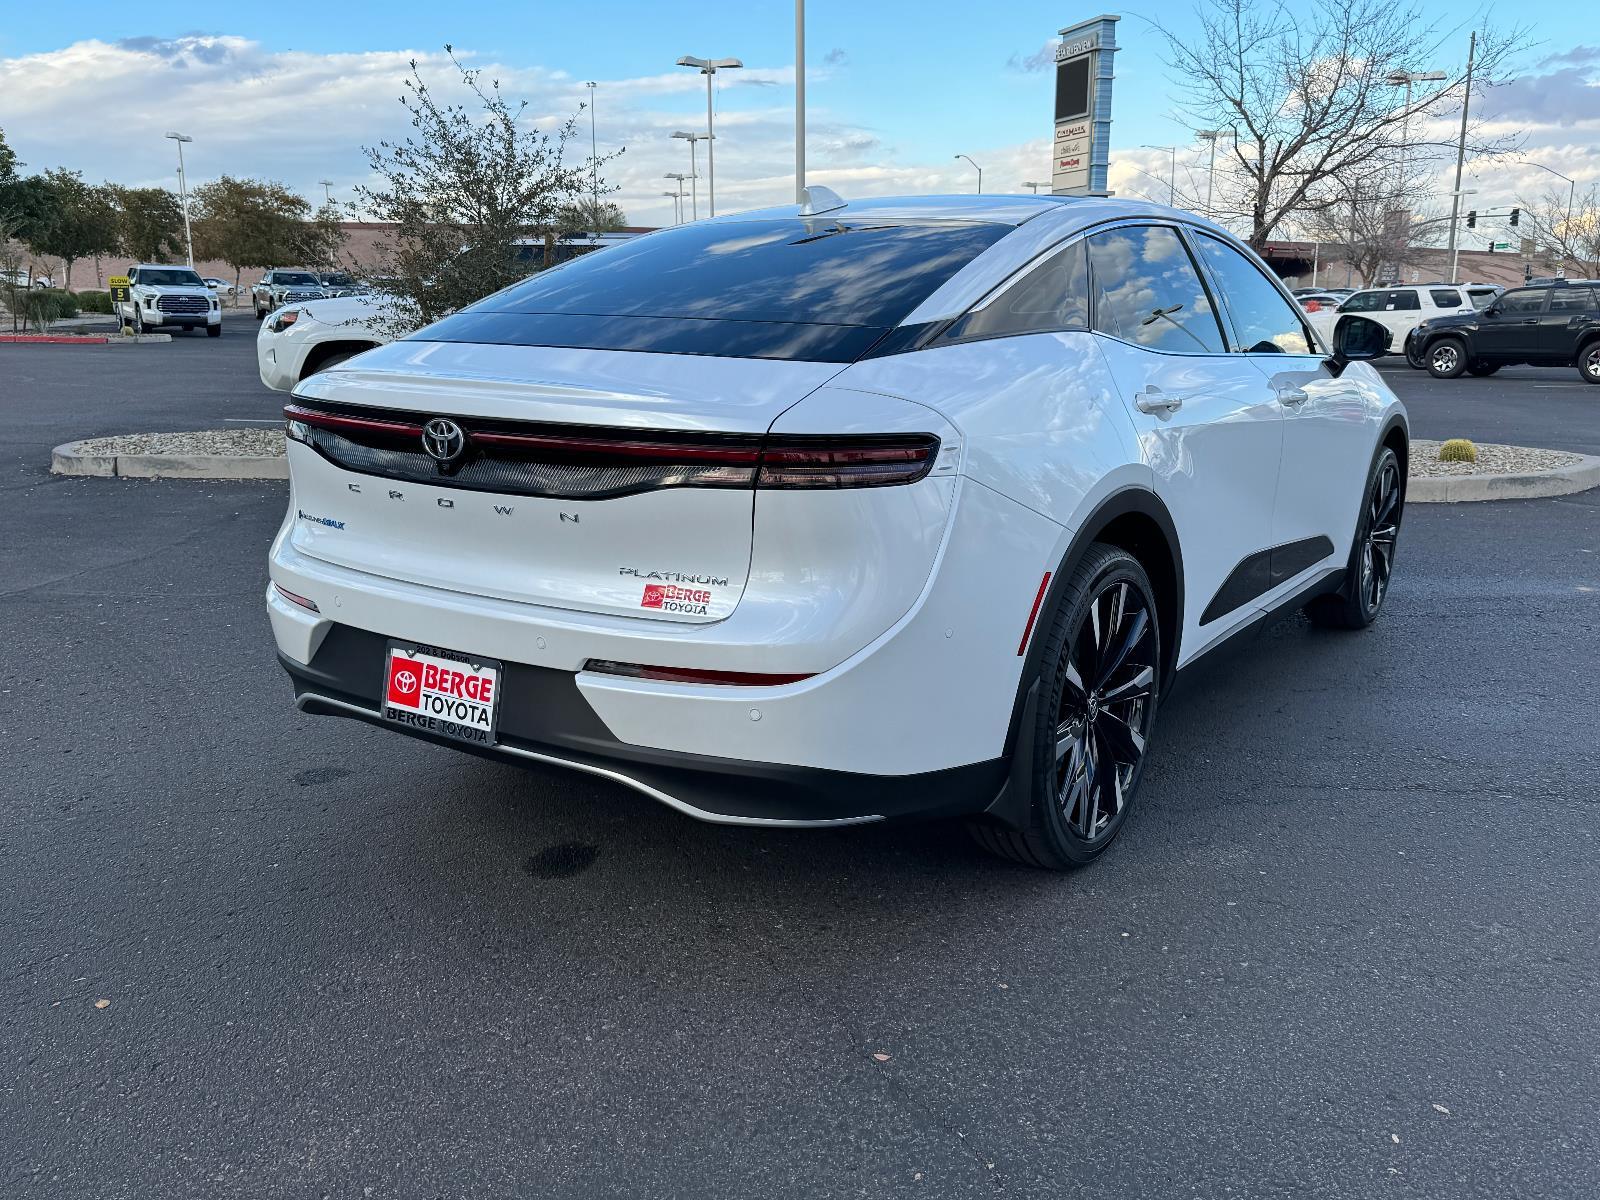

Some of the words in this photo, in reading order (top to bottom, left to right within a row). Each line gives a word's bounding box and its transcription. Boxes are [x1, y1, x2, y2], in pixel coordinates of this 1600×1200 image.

[1057, 125, 1086, 138] CINEMARK
[117, 288, 124, 297] 5
[348, 483, 580, 524] CROWN
[619, 567, 729, 586] PLATINUM
[665, 585, 712, 604] BERGE
[663, 601, 708, 615] TOYOTA
[423, 663, 493, 703] BERGE
[422, 693, 490, 727] TOYOTA
[386, 706, 437, 730] BERGE
[440, 720, 488, 744] TOYOTA
